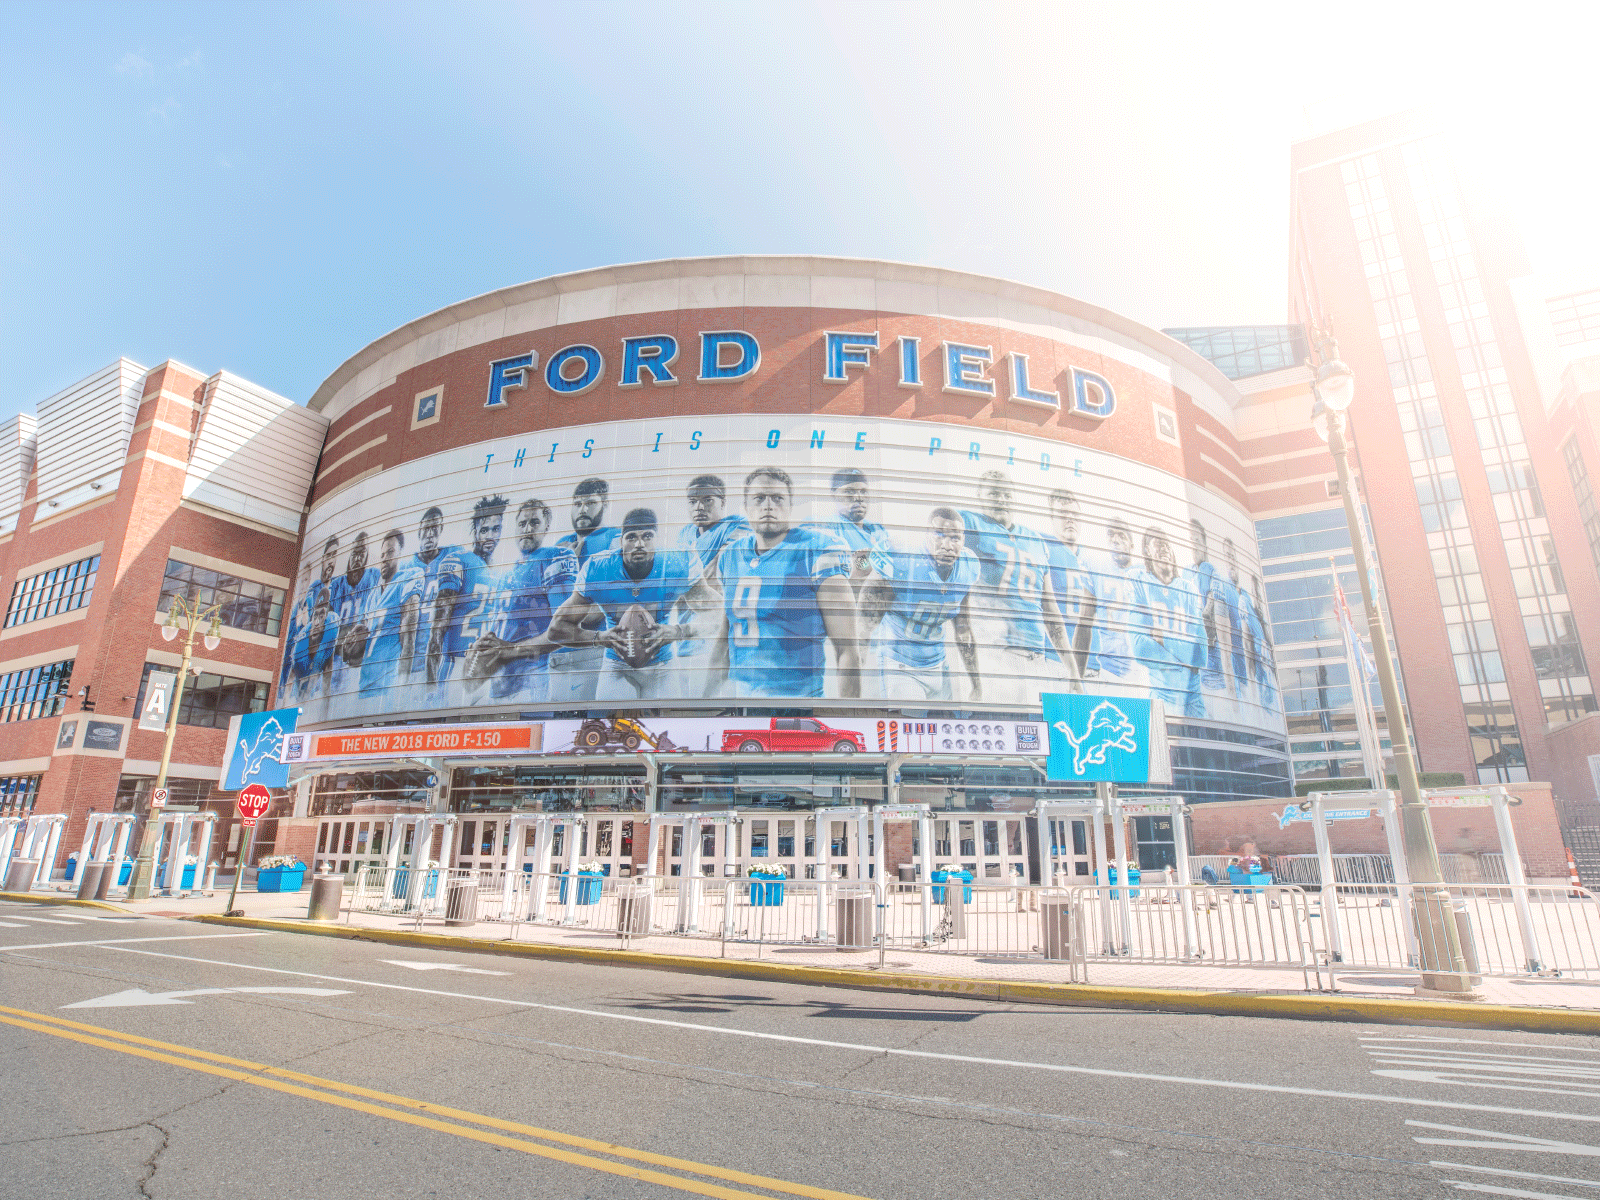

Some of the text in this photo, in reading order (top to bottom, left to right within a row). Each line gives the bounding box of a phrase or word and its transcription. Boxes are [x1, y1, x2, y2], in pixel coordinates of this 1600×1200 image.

[484, 330, 1119, 421] FORD FIELD
[484, 429, 1085, 478] THIS IS ONE PRIDE
[733, 576, 763, 648] 9
[145, 688, 166, 714] A
[340, 731, 501, 752] THE NEW 2018 FORD F-150
[1017, 726, 1037, 734] BUILT
[240, 794, 269, 808] STOP
